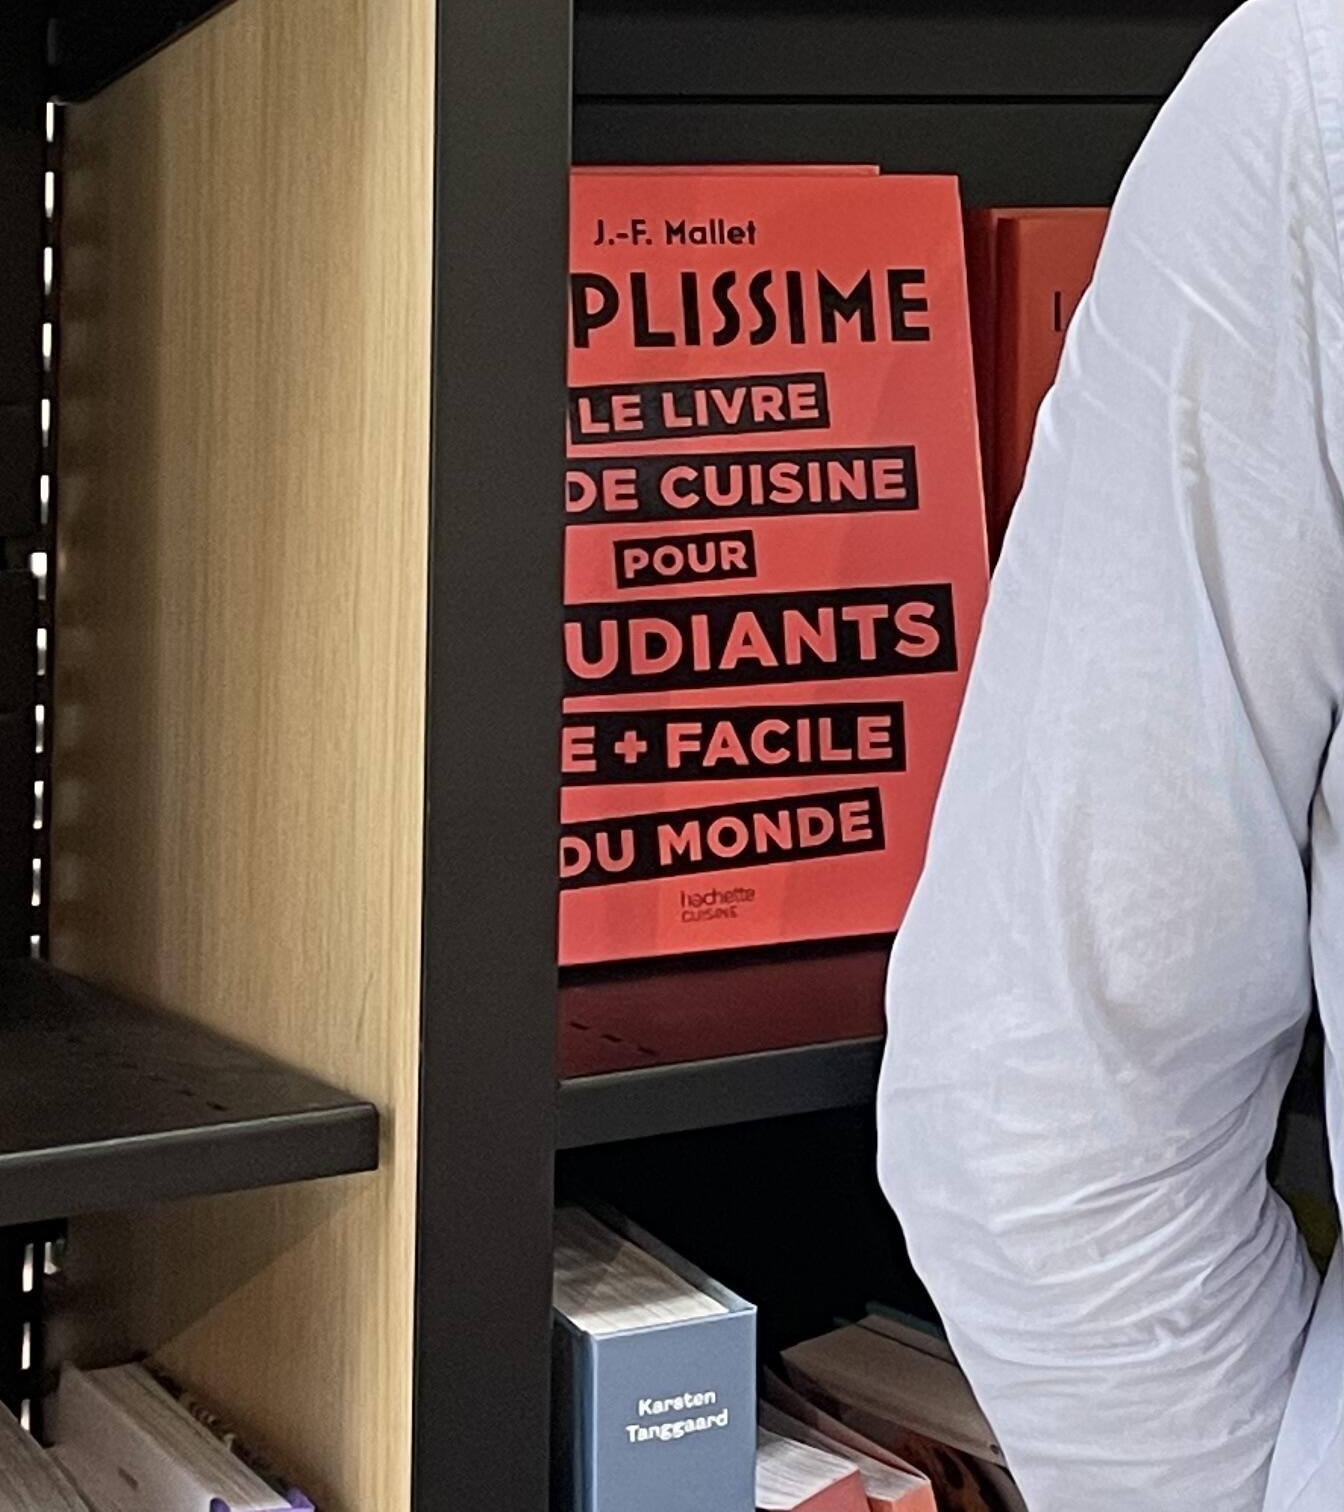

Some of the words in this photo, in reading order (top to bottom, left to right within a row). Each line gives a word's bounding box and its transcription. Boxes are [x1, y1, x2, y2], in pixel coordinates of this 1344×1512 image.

[594, 218, 654, 246] J.-F.
[665, 218, 757, 247] Mallet
[569, 267, 933, 350] PLISSIME
[578, 395, 644, 435] LE
[662, 381, 820, 430] LIVRE
[565, 468, 638, 512] DE
[660, 457, 908, 509] CUISINE
[622, 539, 749, 581] POUR
[564, 601, 942, 682] UDIANTS
[665, 714, 895, 769] FACILE
[560, 826, 636, 880] DU
[659, 798, 874, 868] MONDE
[624, 1407, 729, 1443] Tanggaard
[638, 1391, 716, 1417] Karsten
